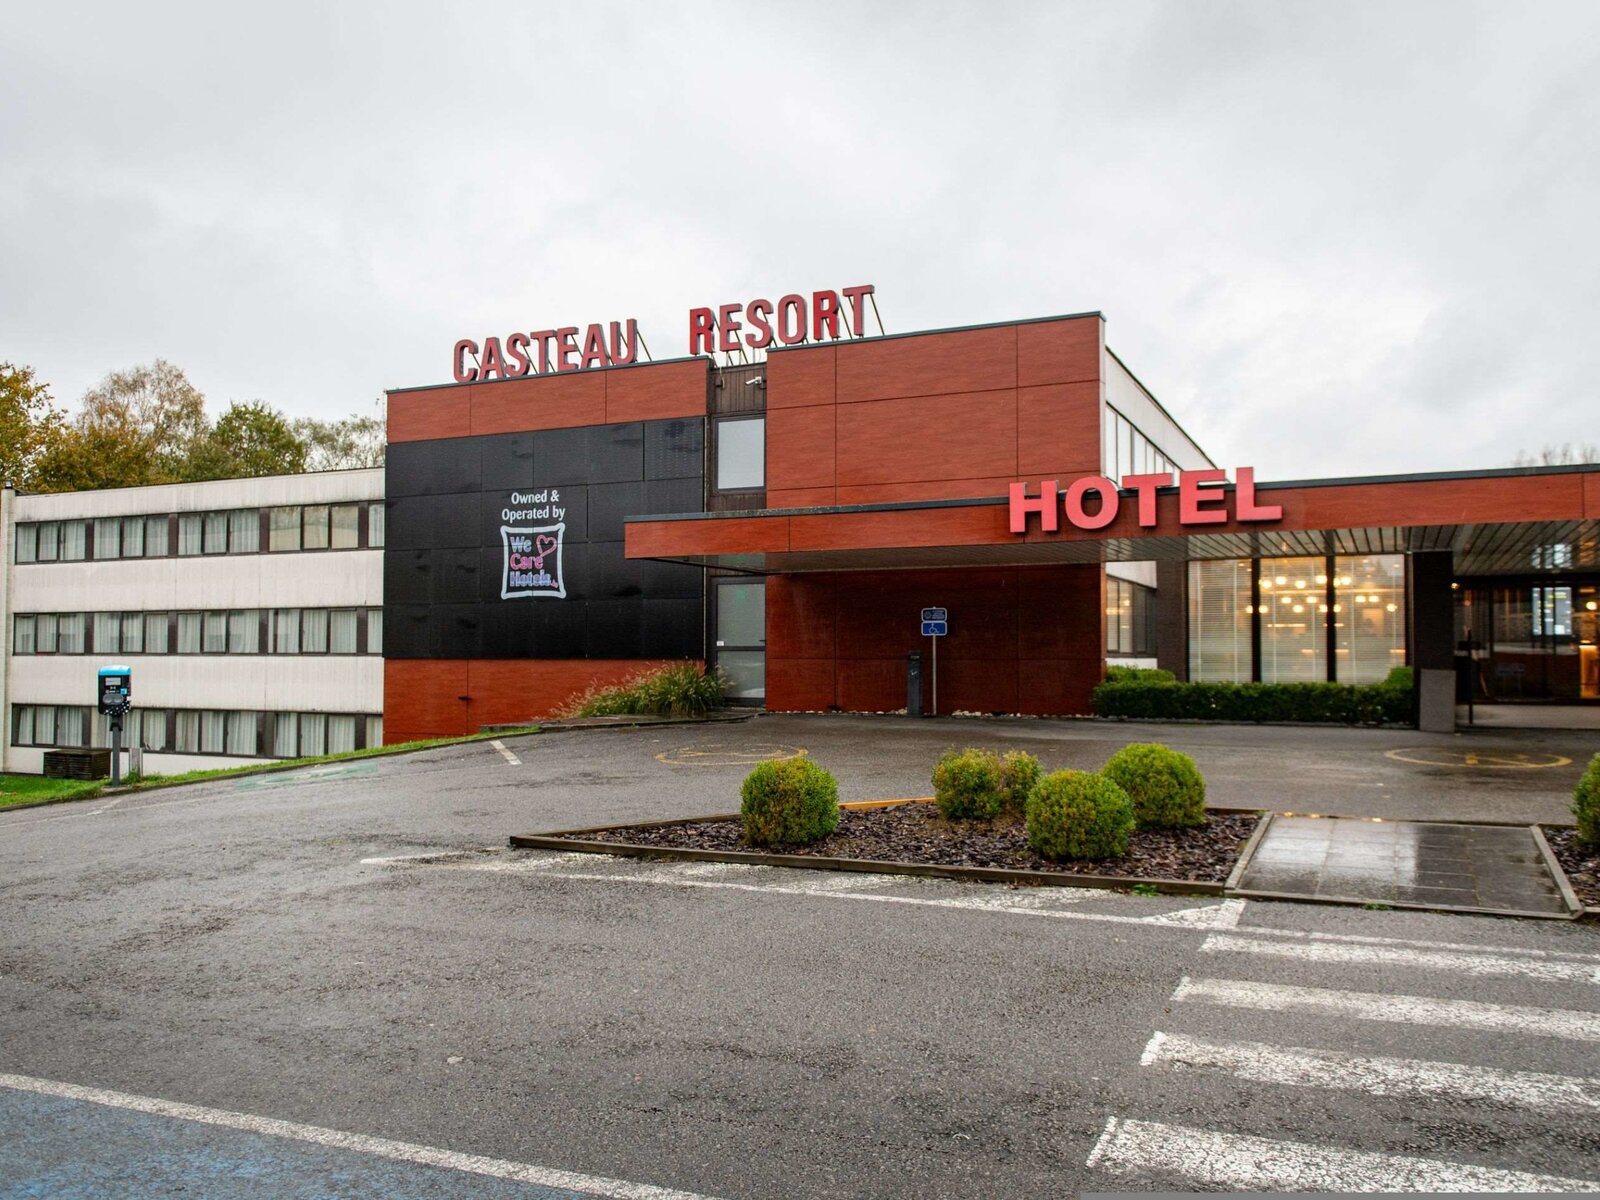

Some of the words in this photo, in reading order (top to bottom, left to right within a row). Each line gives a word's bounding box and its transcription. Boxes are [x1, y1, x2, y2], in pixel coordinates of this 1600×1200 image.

[453, 318, 638, 383] CASTEAU
[689, 284, 875, 355] RESORT
[511, 489, 548, 505] Owned
[550, 489, 560, 502] &
[1009, 467, 1283, 533] HOTEL
[502, 505, 550, 523] Operated
[552, 505, 566, 521] by
[510, 536, 532, 552] We
[510, 553, 544, 570] Care
